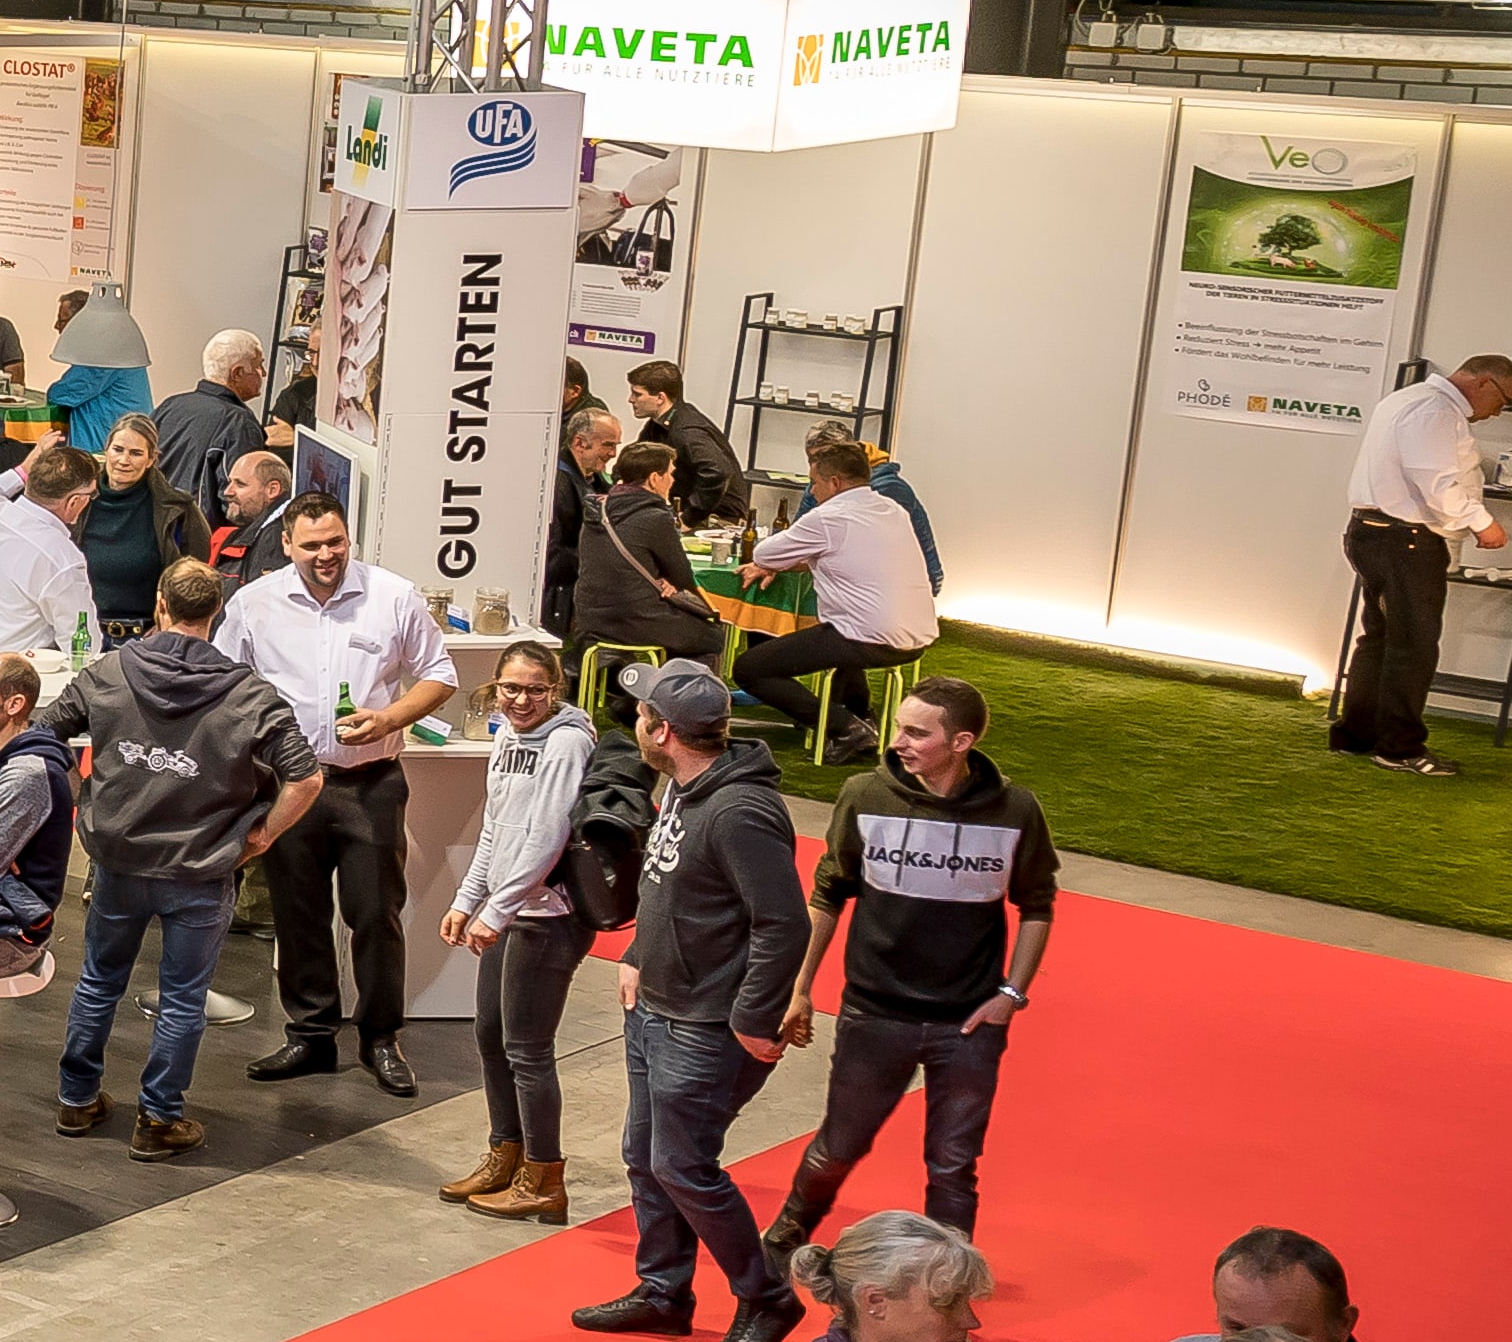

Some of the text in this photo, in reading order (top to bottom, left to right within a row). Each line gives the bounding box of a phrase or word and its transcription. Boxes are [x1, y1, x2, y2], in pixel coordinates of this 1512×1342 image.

[545, 24, 755, 69] NAVETA
[831, 20, 951, 64] NAVETA
[603, 65, 755, 88] ALLE NUTZTIERE
[474, 101, 526, 145] UFA
[345, 124, 388, 171] Landi
[1223, 291, 1249, 300] TIEREN
[597, 331, 643, 345] NAVETA
[1225, 338, 1250, 348] Stress
[1245, 327, 1260, 336] der
[1177, 390, 1232, 408] PHODÉ
[1272, 397, 1363, 419] NAVETA
[437, 252, 504, 580] GUT STARTEN
[865, 845, 1005, 873] JACK&JONES
